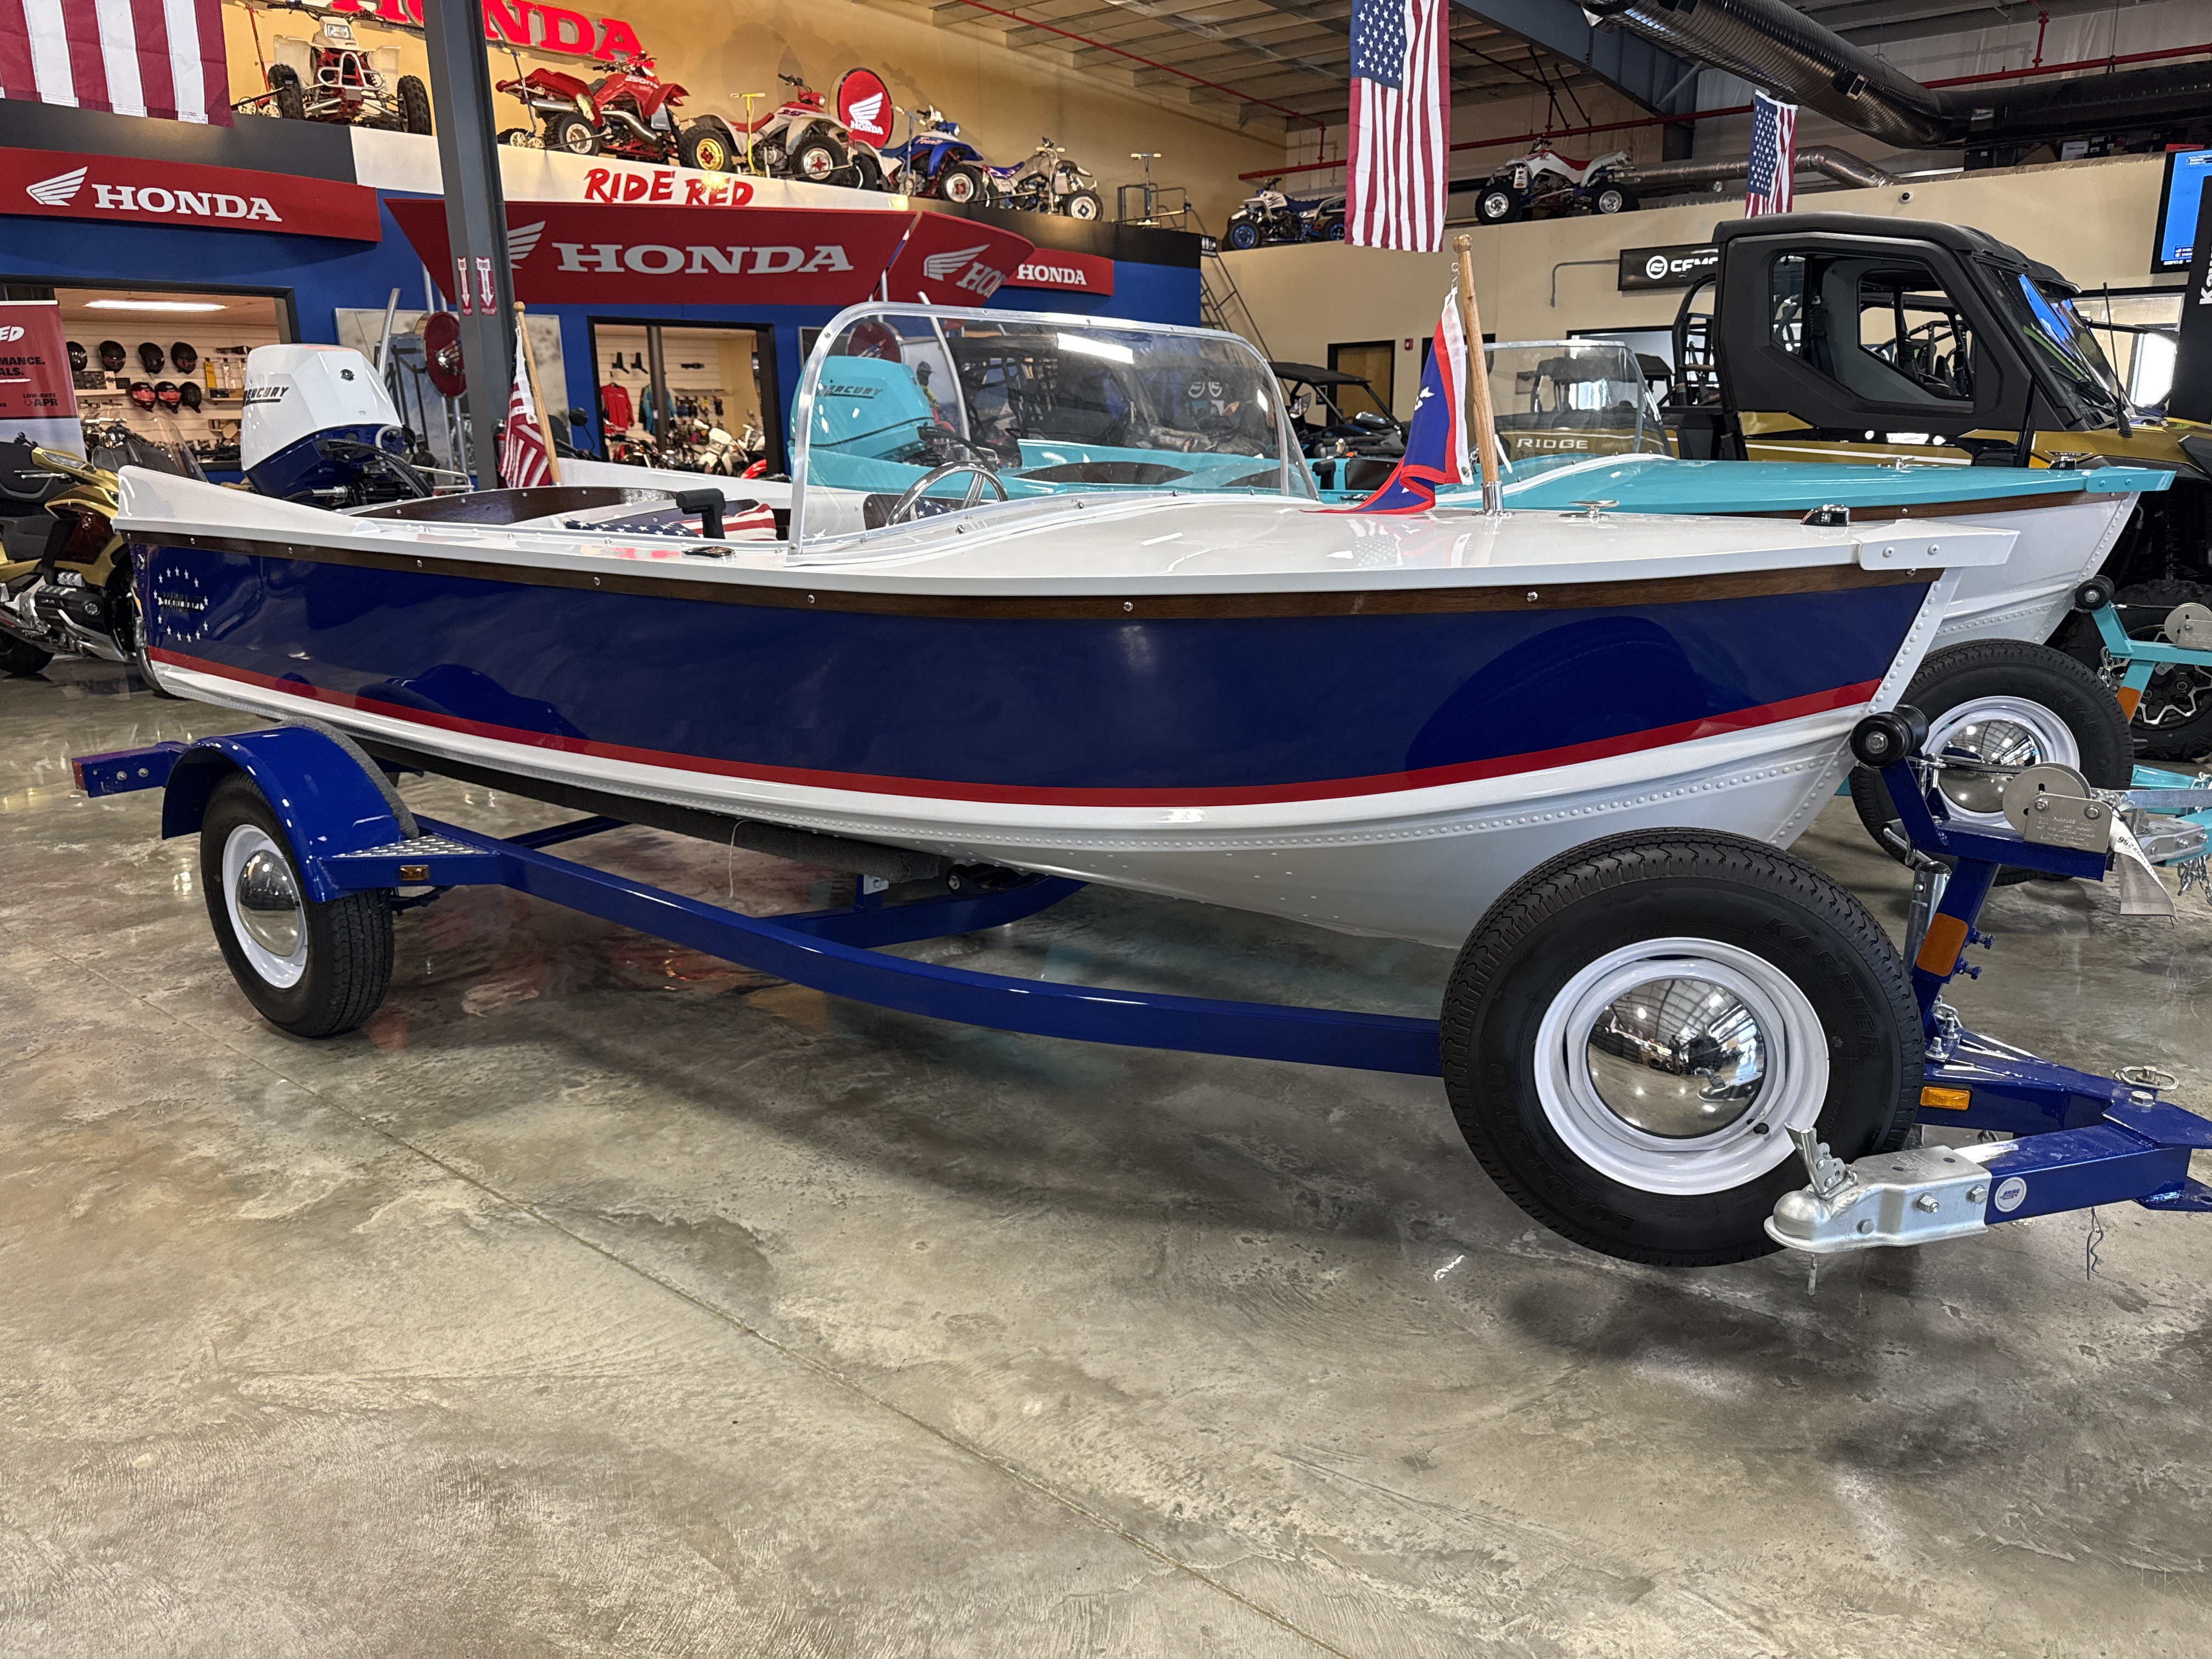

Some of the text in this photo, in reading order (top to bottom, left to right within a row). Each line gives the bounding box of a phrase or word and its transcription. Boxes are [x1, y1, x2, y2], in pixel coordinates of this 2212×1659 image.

[850, 120, 884, 134] HONDA
[92, 184, 282, 222] HONDA
[583, 168, 754, 206] RIDE RED
[552, 242, 854, 274] HONDA
[1017, 264, 1087, 285] HONDA
[1517, 438, 1588, 449] RIDGE
[1760, 916, 1881, 1057] KARRIER
